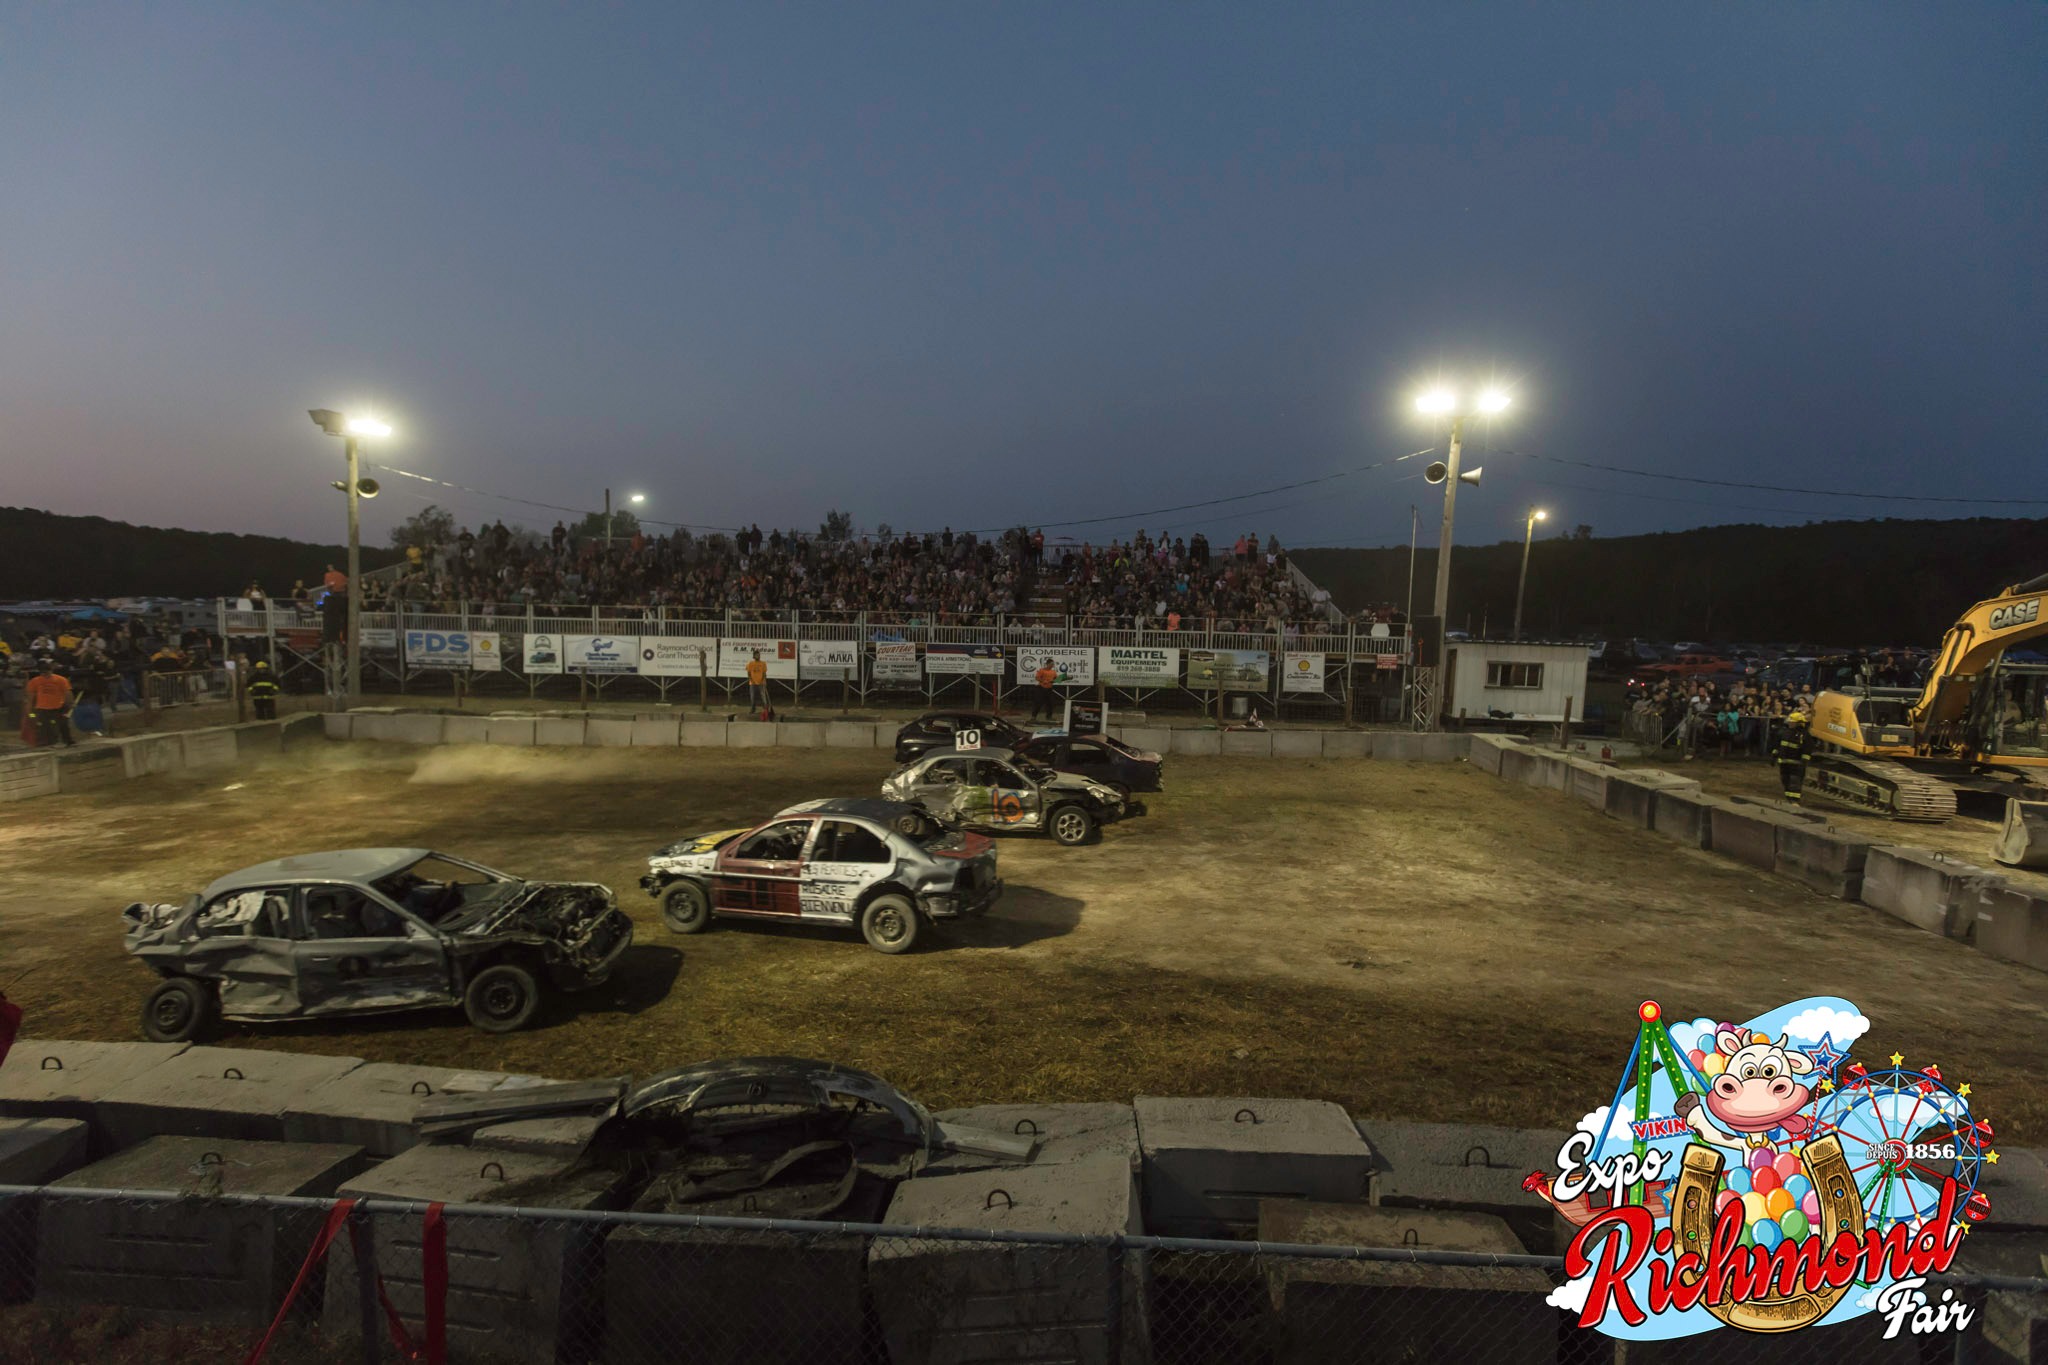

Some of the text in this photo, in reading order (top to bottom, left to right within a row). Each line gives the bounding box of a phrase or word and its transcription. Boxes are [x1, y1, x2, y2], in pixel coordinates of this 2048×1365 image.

[1990, 598, 2041, 630] CASE
[408, 633, 470, 653] FDS
[657, 644, 688, 652] Raymond
[829, 654, 854, 663] MAKA
[1111, 650, 1168, 659] MARTEL
[957, 731, 979, 745] 10
